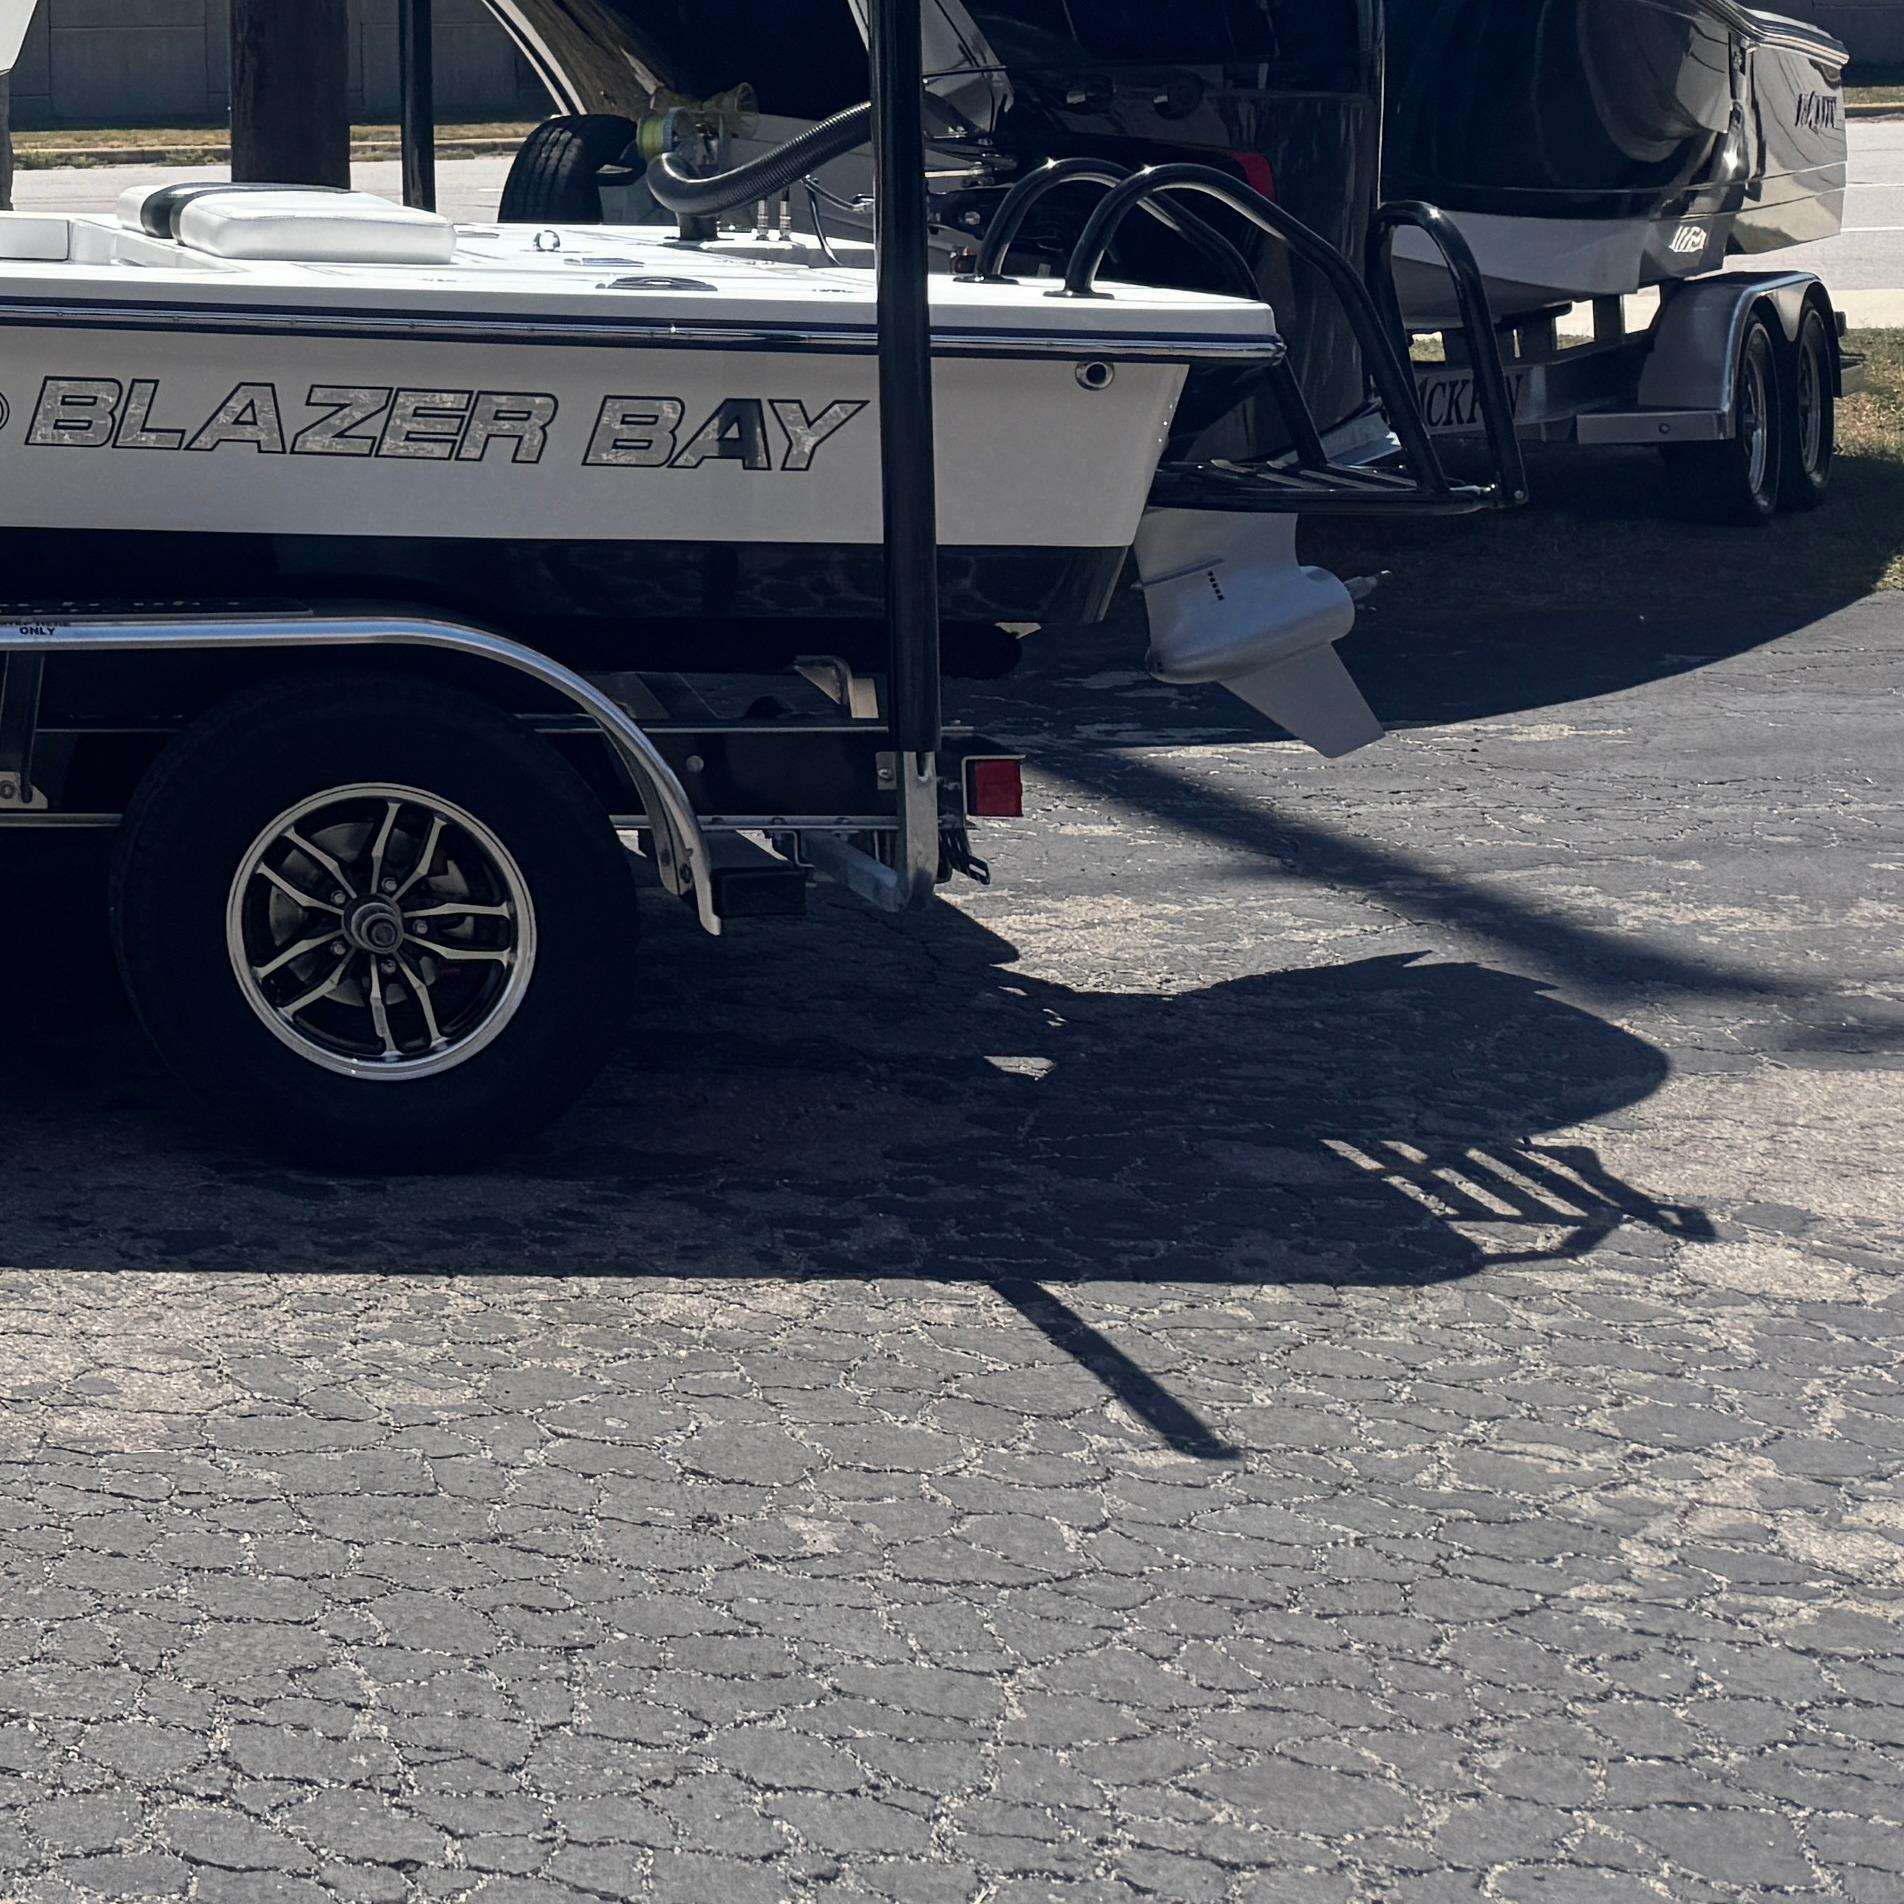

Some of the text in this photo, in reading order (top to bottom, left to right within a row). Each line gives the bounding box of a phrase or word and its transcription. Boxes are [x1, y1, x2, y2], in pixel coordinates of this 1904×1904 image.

[25, 376, 870, 471] BLAZER BAY
[19, 626, 56, 636] ONLY
